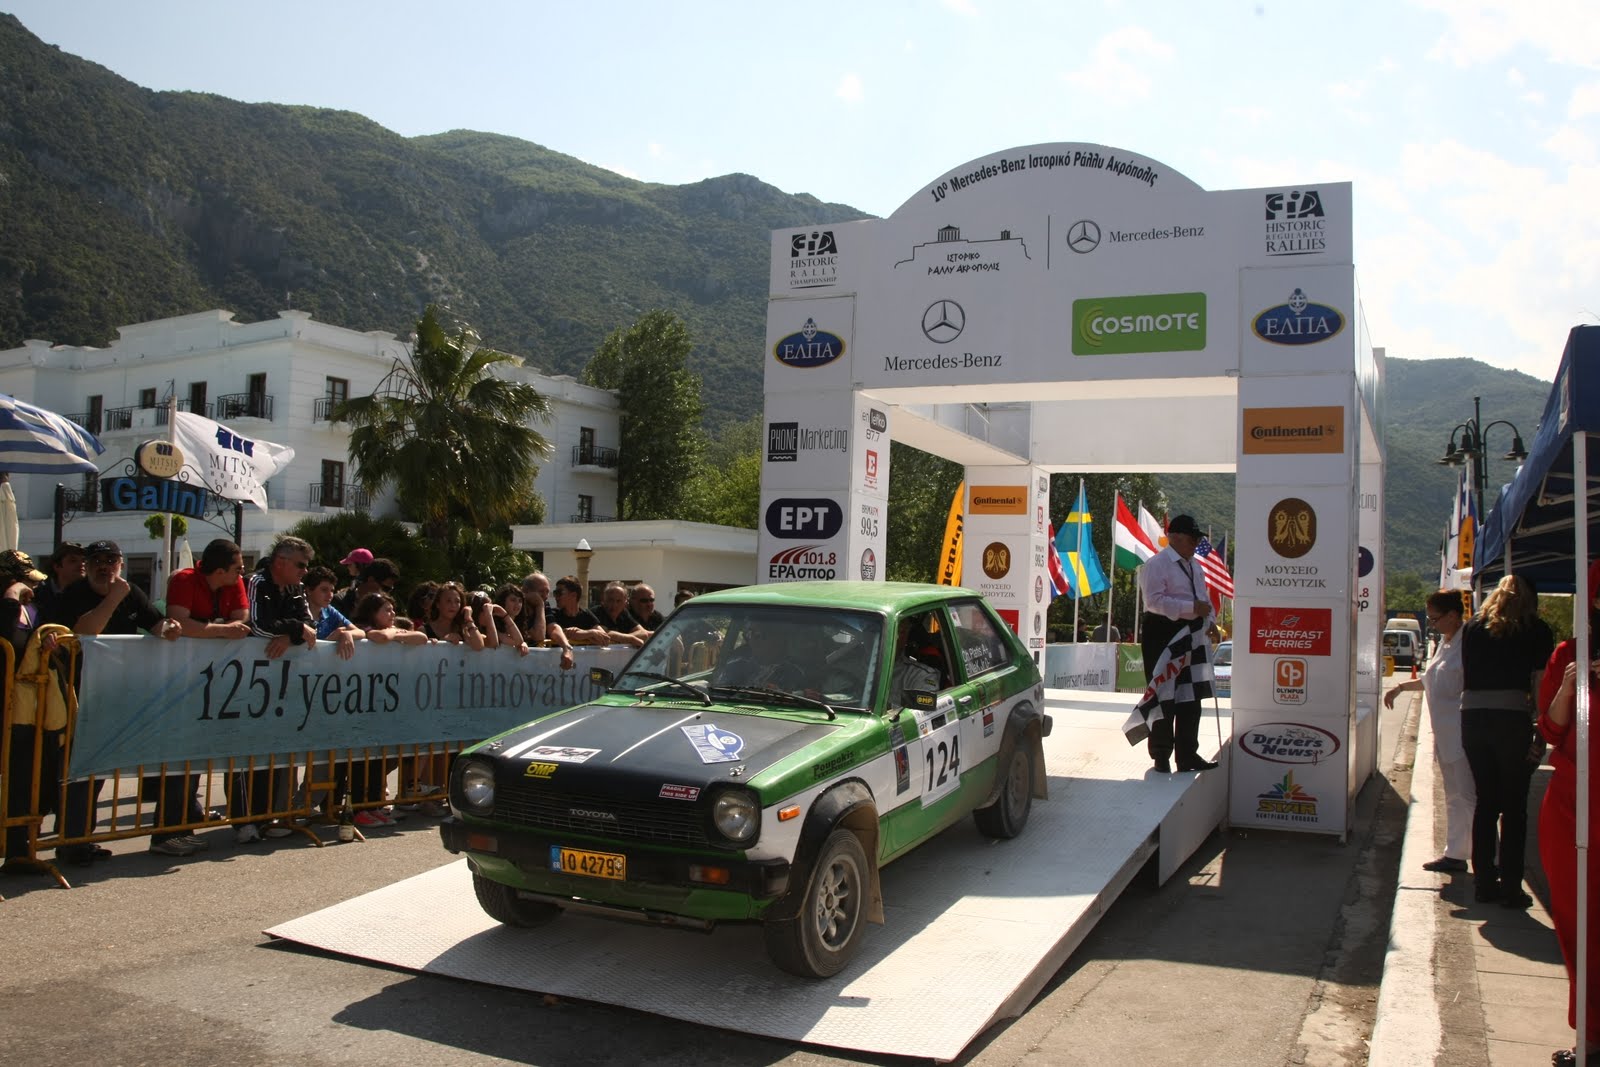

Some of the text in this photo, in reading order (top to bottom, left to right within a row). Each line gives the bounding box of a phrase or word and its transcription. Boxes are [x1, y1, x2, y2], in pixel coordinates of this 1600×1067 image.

[950, 159, 1026, 192] Mercedes-Benz
[1029, 151, 1071, 170] Ιστορικό
[1073, 151, 1105, 169] Ράλλυ
[1105, 156, 1158, 188] Ακρόπολις
[1266, 219, 1326, 233] HISTORIC
[1109, 225, 1204, 243] Mercedes-Benz
[1265, 230, 1325, 241] REGULARITY
[1266, 238, 1326, 253] RALLIES
[791, 256, 838, 268] HISTORIC
[790, 267, 838, 278] RALLY
[790, 277, 837, 286] CHAMPIONSHIP
[1091, 311, 1199, 336] COSMOTE
[1264, 315, 1333, 337] ΕΛΠΑ
[783, 342, 835, 360] ΕΛΠΑ
[884, 352, 1003, 371] Mercedes-Benz
[1251, 425, 1323, 439] Continental
[770, 427, 848, 452] PHONE Marketing
[113, 478, 207, 516] Galini
[973, 497, 1016, 506] Continental
[780, 507, 829, 531] ΕΡΤ
[860, 517, 878, 540] 99,5
[803, 552, 836, 565] 101.8
[1264, 565, 1319, 576] ΜΟΥΣΕΙΟ
[980, 583, 1012, 591] ΜΟΥΣΕΙΟ
[1256, 577, 1327, 589] ΝΑΣΙΟΥΤΖΙΚ
[1256, 629, 1324, 640] SUPERFAST
[1264, 640, 1313, 649] FERRIES
[197, 658, 289, 721] 125!
[296, 666, 400, 731] years
[414, 658, 449, 711] of
[1252, 734, 1324, 747] Drivers
[1261, 744, 1313, 757] News
[526, 764, 557, 776] OMP
[926, 734, 960, 792] 124
[570, 808, 616, 820] TOYOTA
[1257, 799, 1317, 816] STAR
[581, 855, 614, 876] 4279
